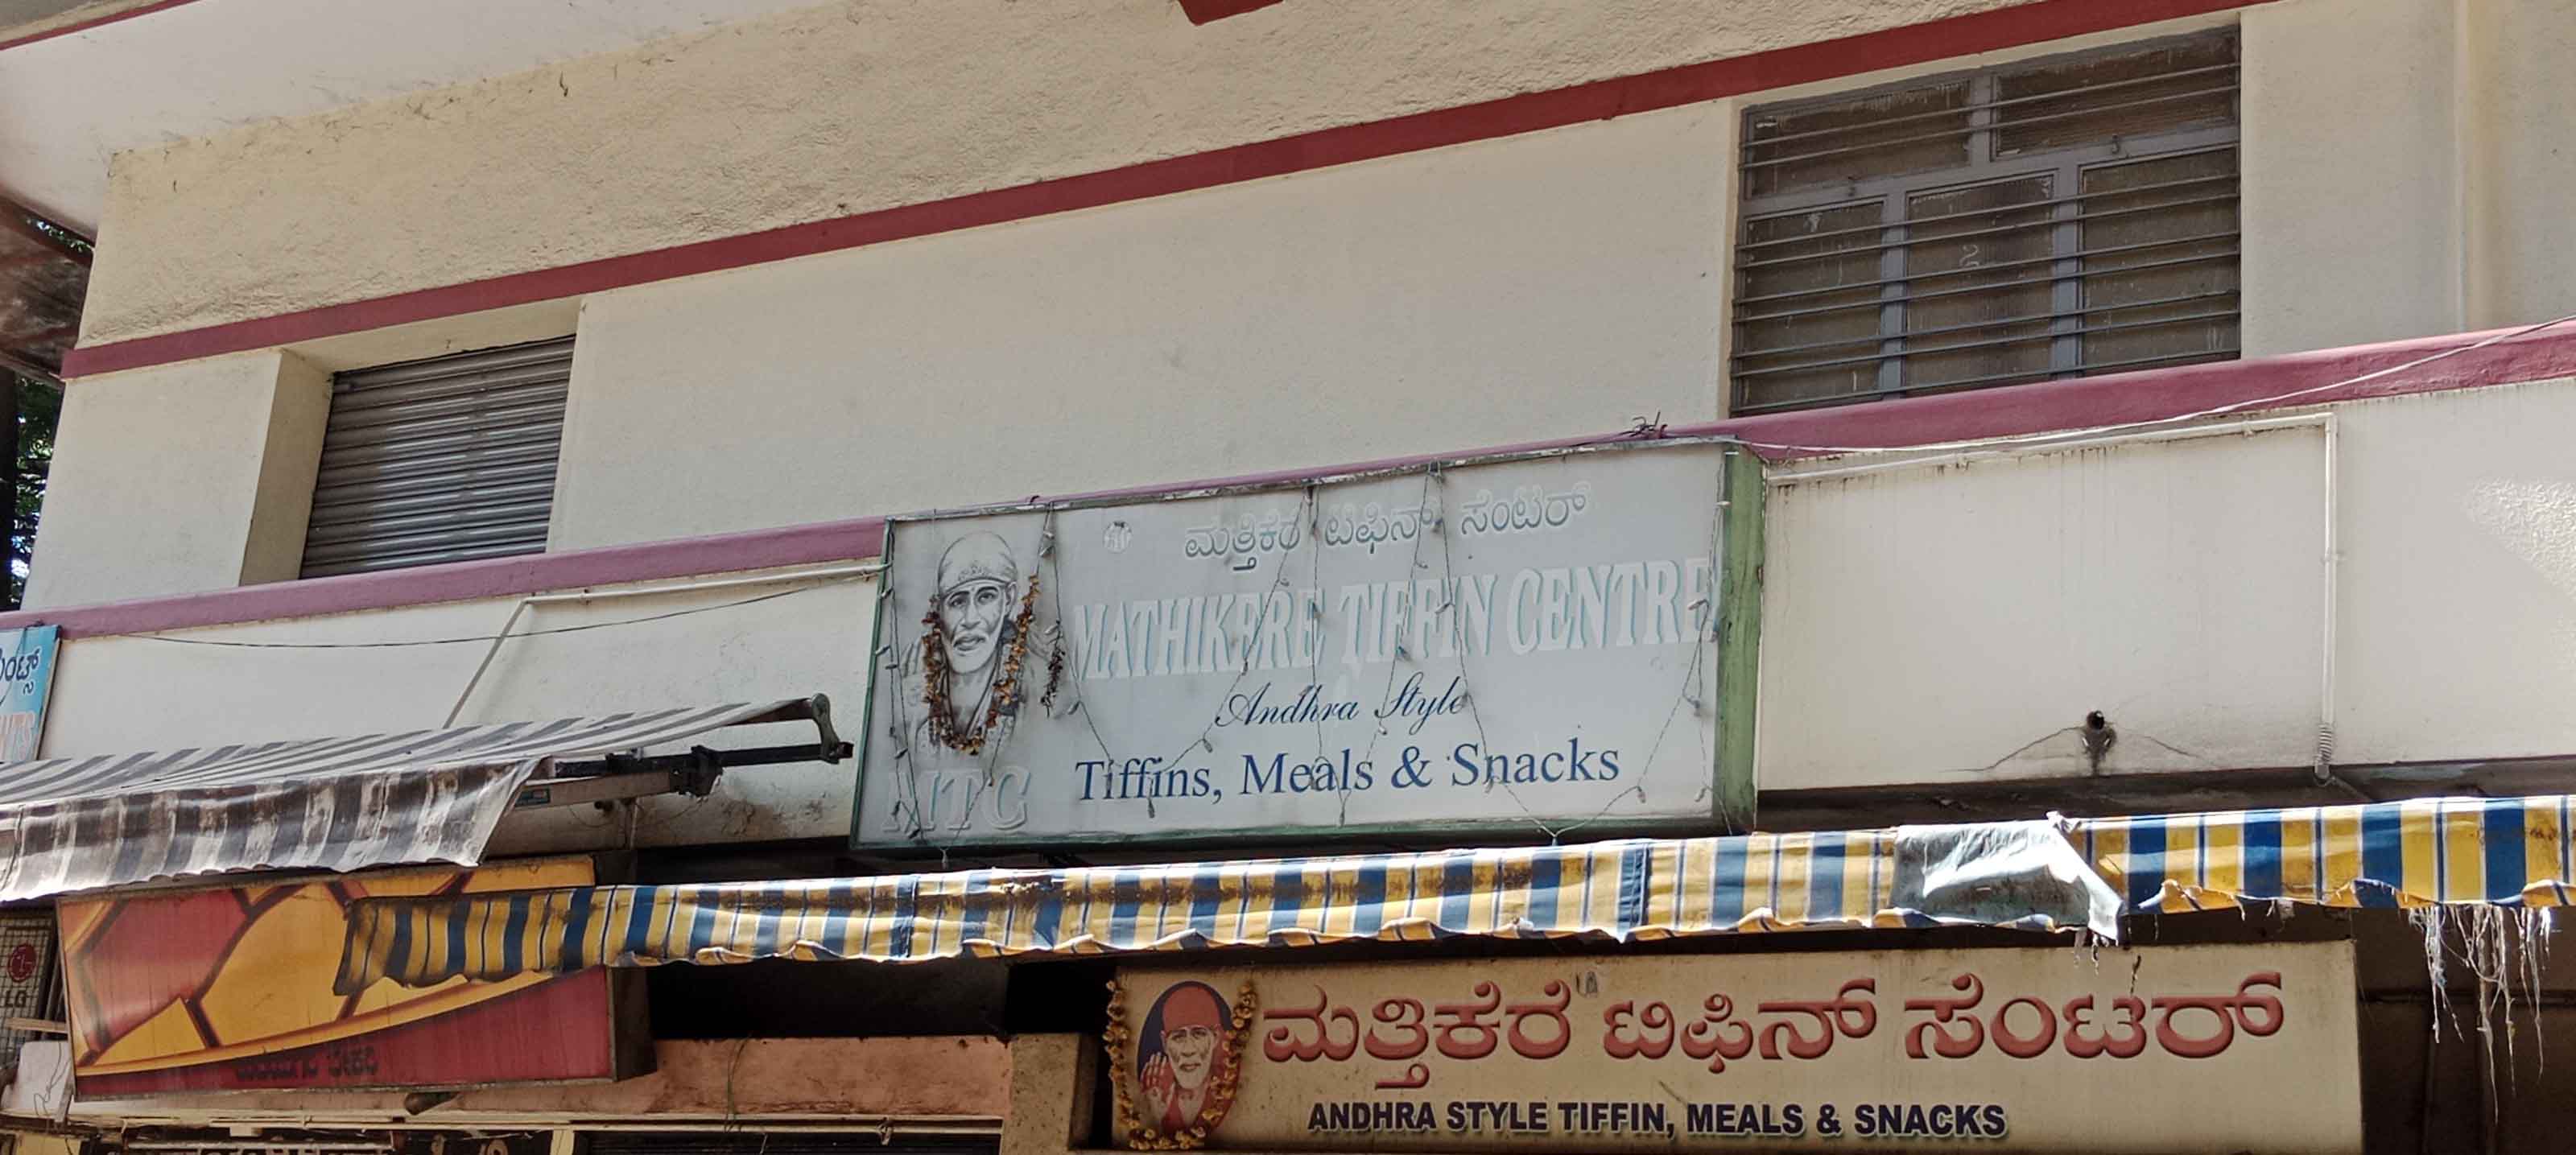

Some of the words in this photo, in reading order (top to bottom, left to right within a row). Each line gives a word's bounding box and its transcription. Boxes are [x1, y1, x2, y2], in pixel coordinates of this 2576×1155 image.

[1074, 588, 1327, 684] MATHIKERE
[1340, 574, 1499, 665] TIFFIN
[1505, 559, 1719, 655] CENTRE
[1215, 681, 1360, 728] Andhra
[1373, 671, 1467, 736] Style
[1075, 757, 1224, 803] Tiffins,
[1239, 749, 1373, 795] Meals
[1389, 745, 1433, 789] &
[1451, 737, 1620, 786] Snacks
[1263, 978, 1573, 1090] ಮತ್ತಿಕೆರೆ
[1602, 980, 1878, 1075] ಟಿಫಿನ್
[1904, 971, 2285, 1060] ಸೆಂಟರ್
[1307, 1100, 1438, 1133] ANDHRA
[1447, 1102, 1549, 1133] STYLE
[1557, 1102, 1678, 1137] TIFFIN,
[1687, 1103, 1805, 1135] MEALS
[1815, 1104, 1843, 1136] &
[1854, 1103, 2008, 1137] SNACKS
